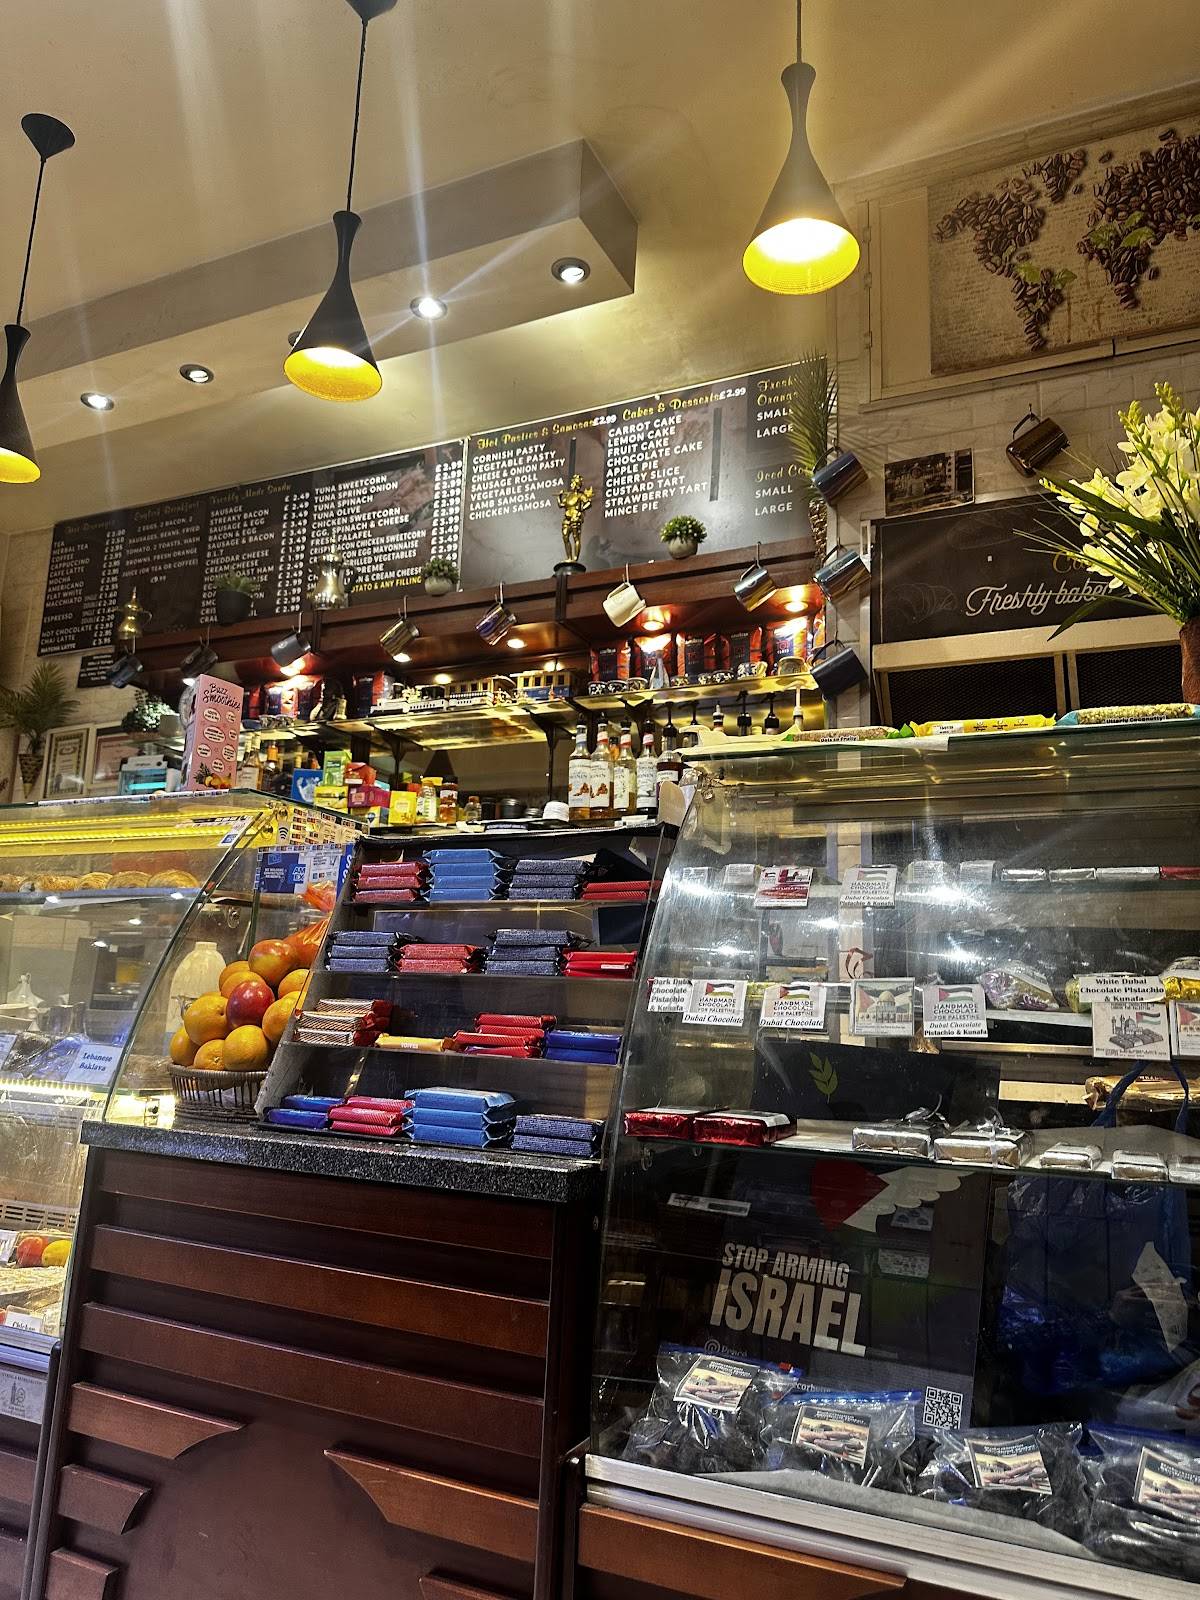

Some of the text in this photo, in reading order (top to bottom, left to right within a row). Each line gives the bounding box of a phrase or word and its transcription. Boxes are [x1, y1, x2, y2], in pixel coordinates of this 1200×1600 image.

[623, 407, 654, 421] Cakes
[657, 403, 665, 413] &
[718, 387, 747, 400] £2.99
[757, 408, 793, 421] SMALL
[477, 437, 498, 449] Hot
[592, 414, 617, 426] £2.99
[608, 415, 682, 437] CARROT CAKE
[756, 424, 794, 438] LARGE
[608, 426, 676, 448] LEMON CAKE
[473, 444, 546, 465] CORNISH PASTY
[607, 438, 669, 458] FRUIT CAKE
[607, 441, 703, 467] CHOCOLATE CAKE
[472, 471, 500, 483] CHEESE
[510, 464, 537, 476] ONION
[540, 458, 566, 470] PASTY
[473, 451, 556, 473] VEGETABLE PASTY
[606, 460, 659, 478] APPLE PIE
[314, 485, 336, 495] TUNA
[338, 475, 387, 491] SWEETCORN
[471, 473, 538, 492] SAUSAGE ROLL
[606, 466, 680, 488] CHERRY SLICE
[314, 481, 399, 503] TUNA SPRING ONION
[471, 477, 564, 501] VEGETABLE SAMOSA
[605, 475, 685, 498] CUSTARD TART
[605, 482, 708, 508] STRAWBERRY TART
[755, 484, 793, 499] SMALL
[313, 495, 374, 512] TUNA SPINACH
[469, 499, 552, 520] CHICKEN SAMOSA
[470, 493, 536, 511] LAMB SAMOSA
[604, 501, 659, 518] MINCE PIE
[755, 502, 793, 516] LARGE
[209, 508, 270, 526] STREAKY BACON
[210, 505, 243, 518] SAUSAGE
[311, 507, 401, 529] CHICKEN SWEETCORN
[312, 506, 361, 521] TUNA OLIVE
[209, 523, 241, 534] SAUSAGE
[250, 518, 265, 526] EGG
[332, 522, 367, 535] SPINACH
[369, 520, 376, 528] &
[377, 514, 410, 527] CHEESE
[207, 539, 239, 550] SAUSAGE
[249, 532, 275, 543] BACON
[208, 532, 234, 542] BACON
[242, 527, 257, 536] EGG
[338, 530, 372, 542] FALAFEL
[356, 537, 385, 547] CHICKEN
[386, 530, 426, 543] SWEETCORN
[358, 540, 419, 556] EGG MAYONNAISE
[374, 549, 417, 562] VEGETABLES
[205, 559, 259, 574] CREAM CHEESE
[206, 549, 270, 566] CHEDDAR CHEESE
[257, 565, 275, 574] HAM
[371, 571, 395, 581] CREAM
[380, 579, 394, 589] ANY
[396, 576, 422, 586] FILLING
[965, 583, 1052, 617] Freshly
[708, 1015, 744, 1024] Chocolate
[785, 1018, 824, 1026] Chocolate
[722, 1243, 850, 1288] STOP ARMING
[710, 1268, 866, 1357] ISRAEL
